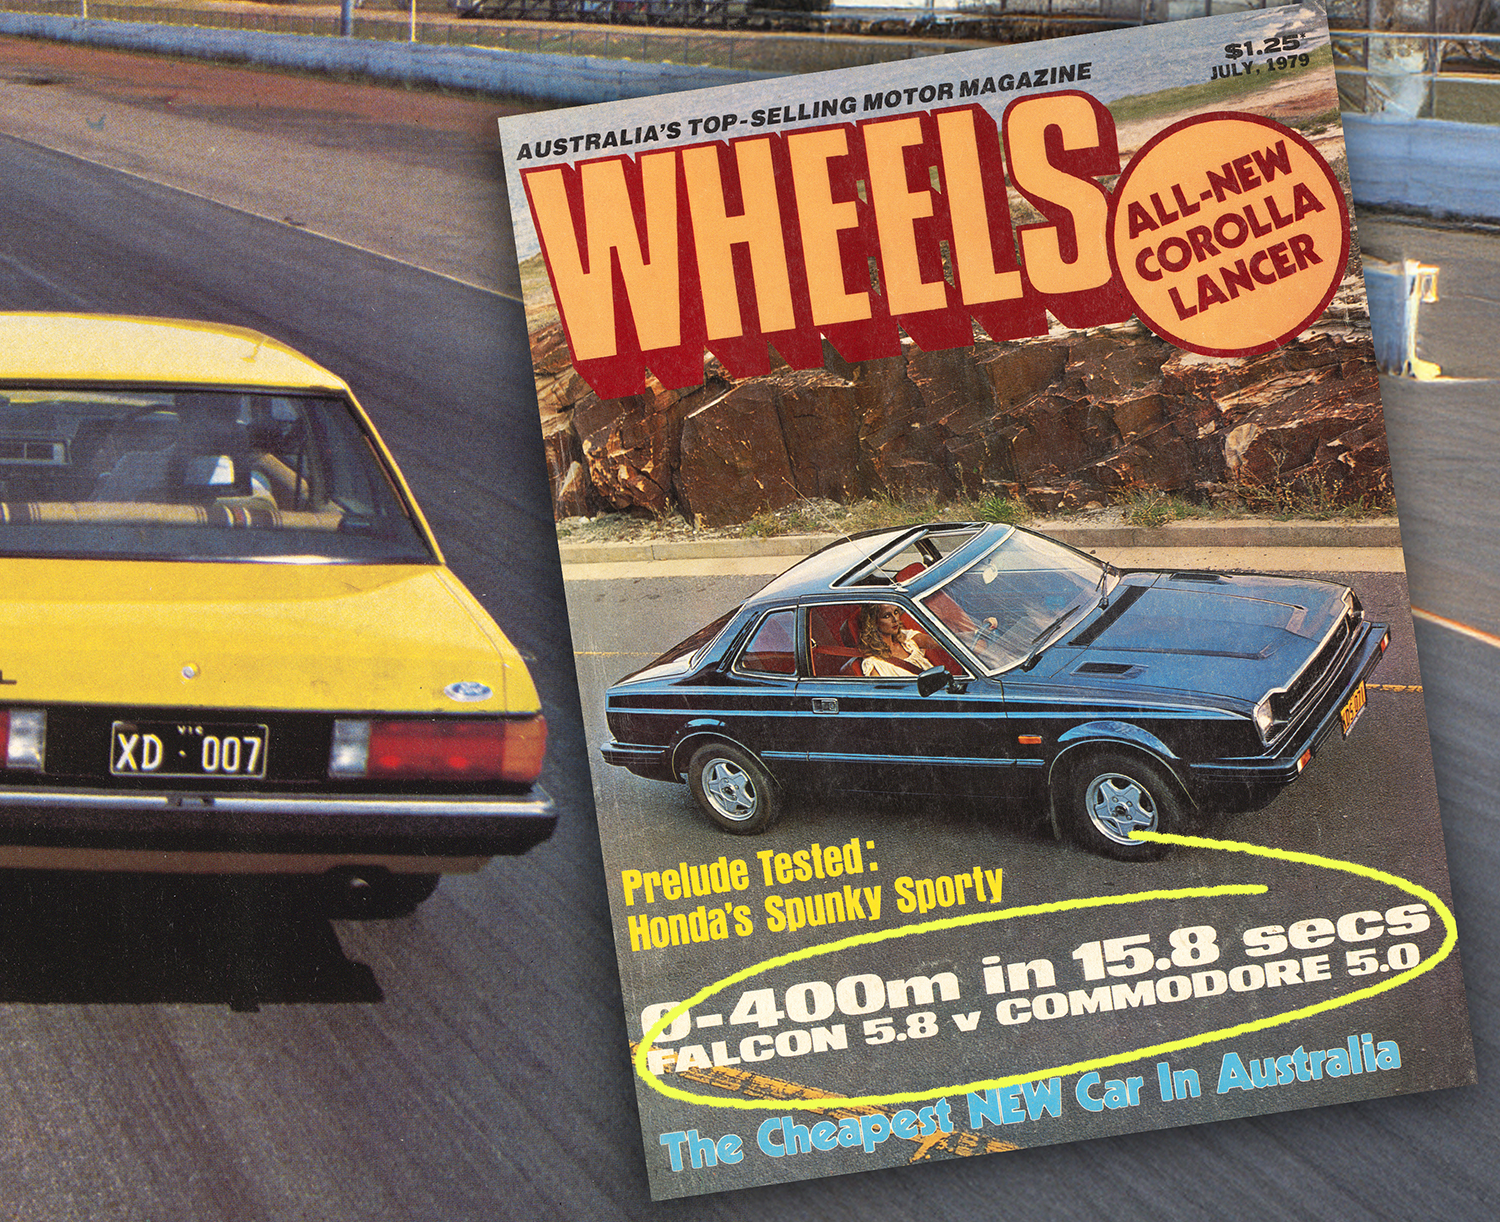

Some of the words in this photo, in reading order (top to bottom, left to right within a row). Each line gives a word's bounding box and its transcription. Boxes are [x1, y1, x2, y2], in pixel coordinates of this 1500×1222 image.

[516, 122, 682, 161] AUSTRALIA'S
[688, 97, 857, 136] TOP-SELLING
[863, 83, 954, 112] MOTOR
[959, 62, 1093, 98] MAGAZINE
[1211, 61, 1260, 81] JULY,
[1266, 53, 1311, 72] 1979
[522, 92, 1114, 362] WHEELS
[1128, 139, 1293, 240] ALL-NEW
[1135, 182, 1327, 282] COROLLA
[1168, 233, 1324, 321] LANCER
[116, 734, 163, 771] XD
[202, 736, 262, 772] 007
[621, 856, 750, 906] Prelude
[627, 900, 754, 952] Honda's
[764, 884, 882, 933] Spunky
[894, 866, 1004, 915] Sporty
[640, 971, 961, 1044] 0-400m
[982, 955, 1056, 995] in
[1072, 924, 1220, 982] 15.8
[1242, 903, 1432, 958] secs
[646, 1024, 849, 1076] FALCON
[863, 1011, 939, 1046] 5.8
[952, 1011, 982, 1033] v
[995, 954, 1332, 1027] COMMODORE
[1347, 942, 1421, 977] 5.0
[660, 1128, 744, 1172] The
[757, 1096, 954, 1159] Cheapest
[966, 1076, 1062, 1131] NEW
[1075, 1071, 1145, 1112] Car
[1156, 1061, 1202, 1102] In
[1216, 1033, 1402, 1095] Australia
